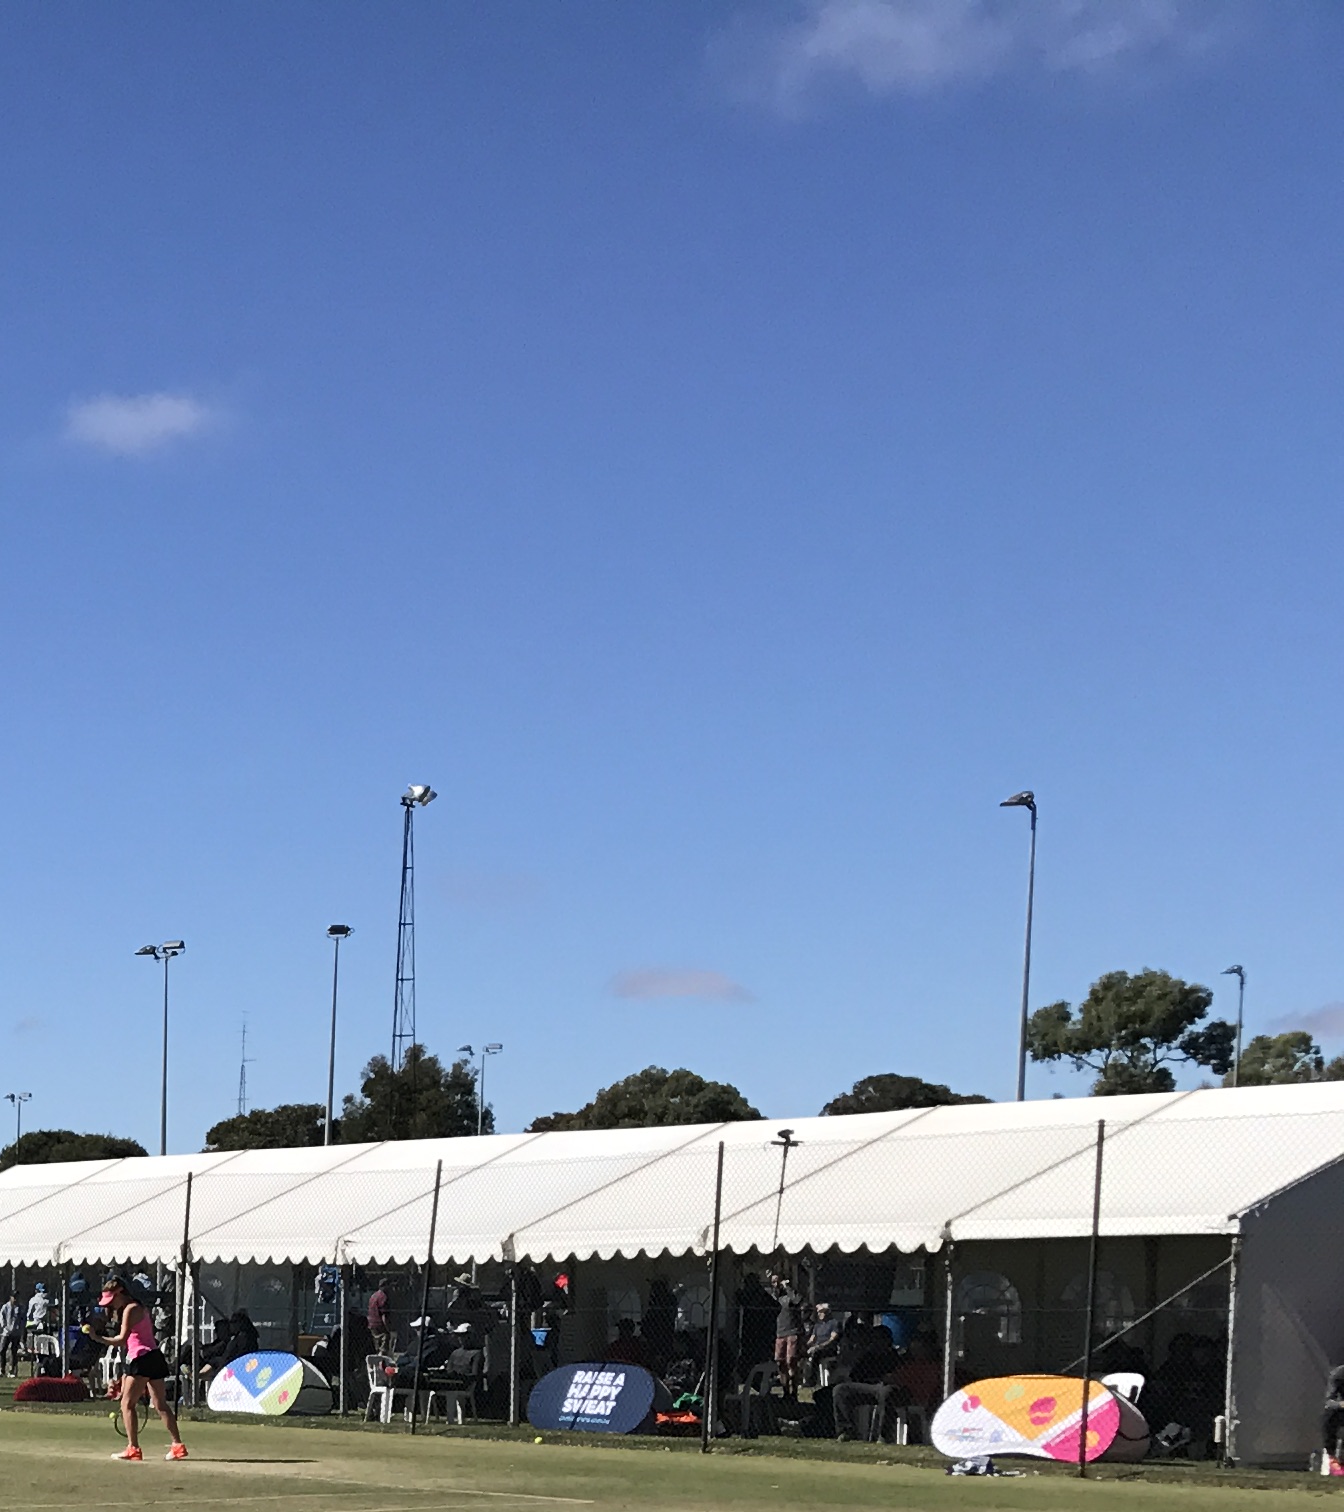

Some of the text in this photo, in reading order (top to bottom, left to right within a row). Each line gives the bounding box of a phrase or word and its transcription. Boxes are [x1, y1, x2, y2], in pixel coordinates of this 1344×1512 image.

[572, 1371, 626, 1386] RAISE A
[566, 1383, 623, 1400] HAPPY
[561, 1398, 617, 1415] SWEAT
